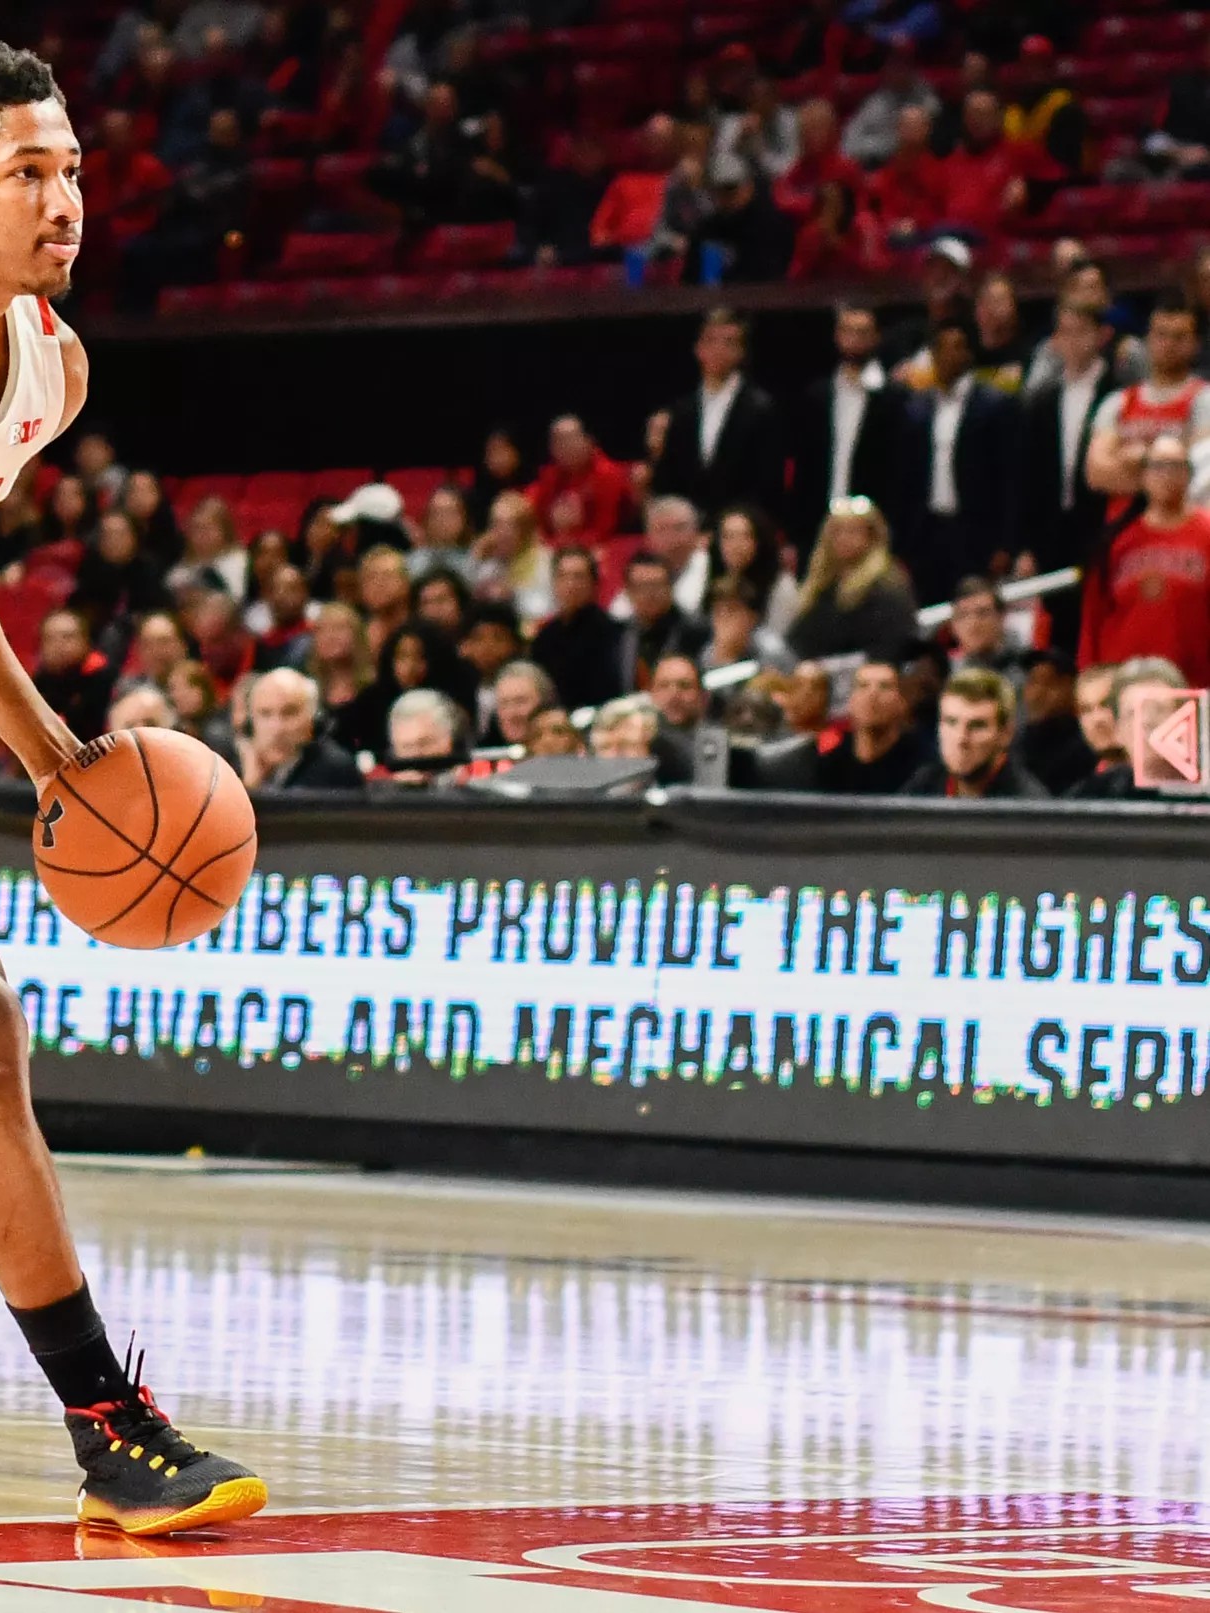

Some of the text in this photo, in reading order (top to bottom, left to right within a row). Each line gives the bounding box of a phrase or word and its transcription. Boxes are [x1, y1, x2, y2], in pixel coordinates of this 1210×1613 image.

[445, 878, 740, 970] PROVIDE
[775, 886, 900, 977] THE
[346, 993, 484, 1080] AND
[516, 999, 996, 1103] MECHANICAL
